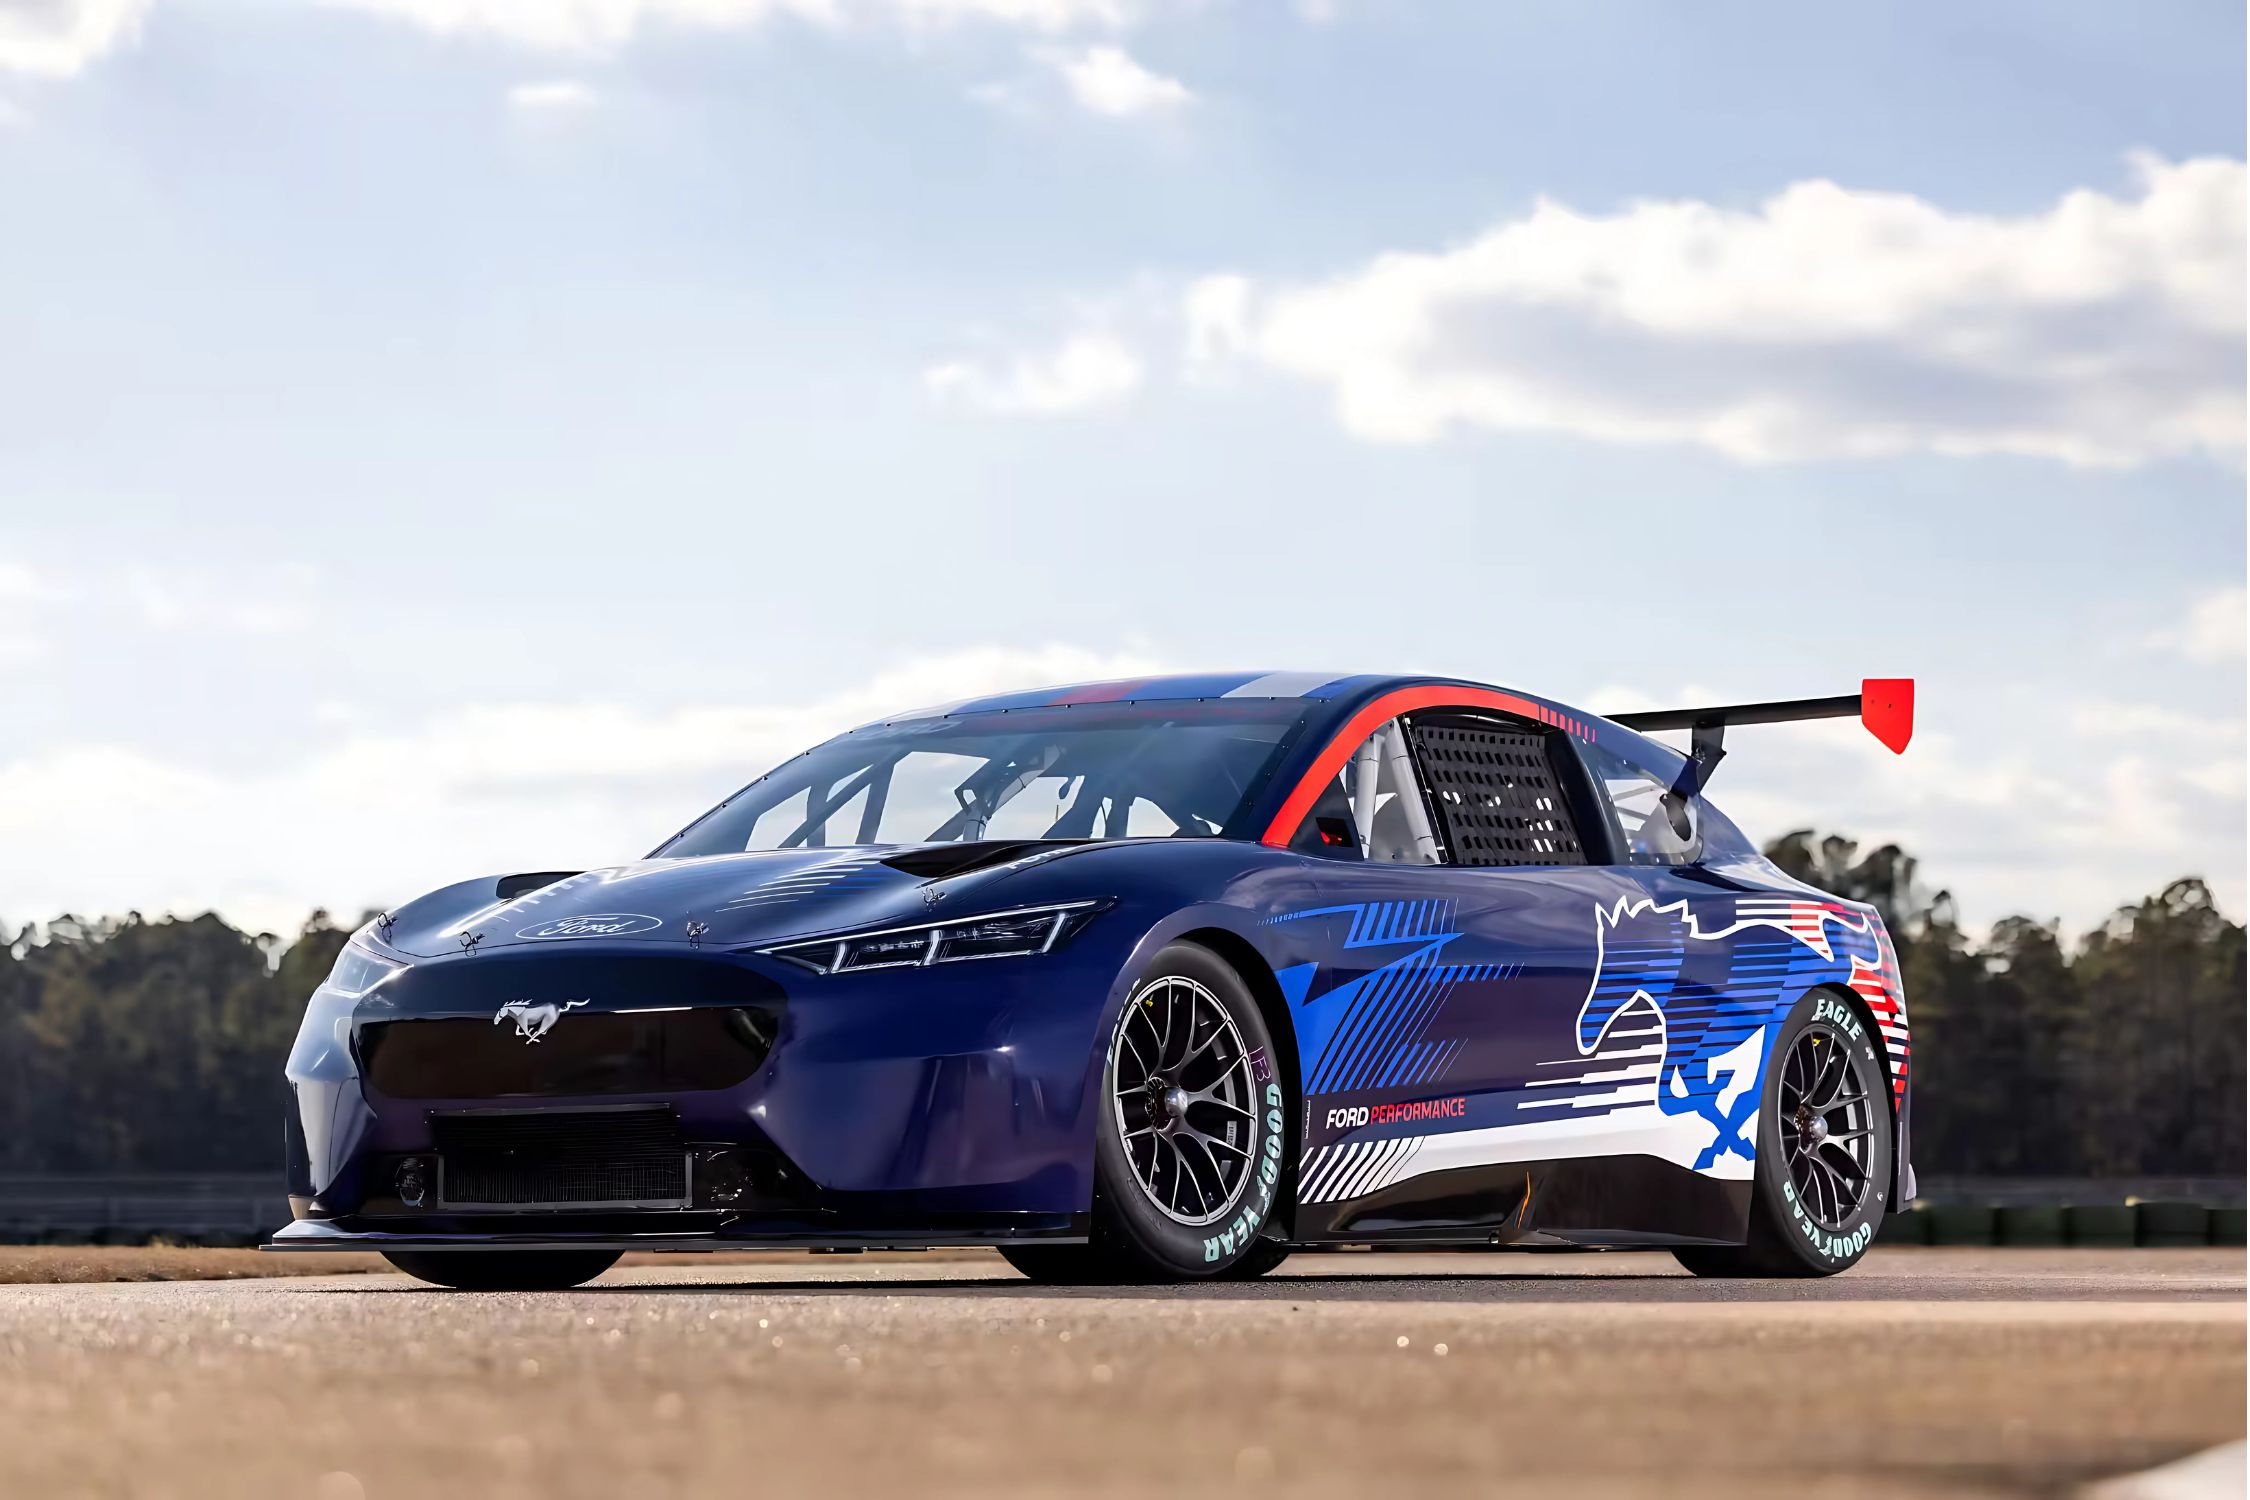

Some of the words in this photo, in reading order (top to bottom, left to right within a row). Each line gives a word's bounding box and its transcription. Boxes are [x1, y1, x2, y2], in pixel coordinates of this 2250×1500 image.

[537, 916, 636, 936] Ford
[1811, 998, 1863, 1042] EAGLE
[1325, 1106, 1369, 1130] FORD
[1370, 1098, 1466, 1125] PERFORMANCE
